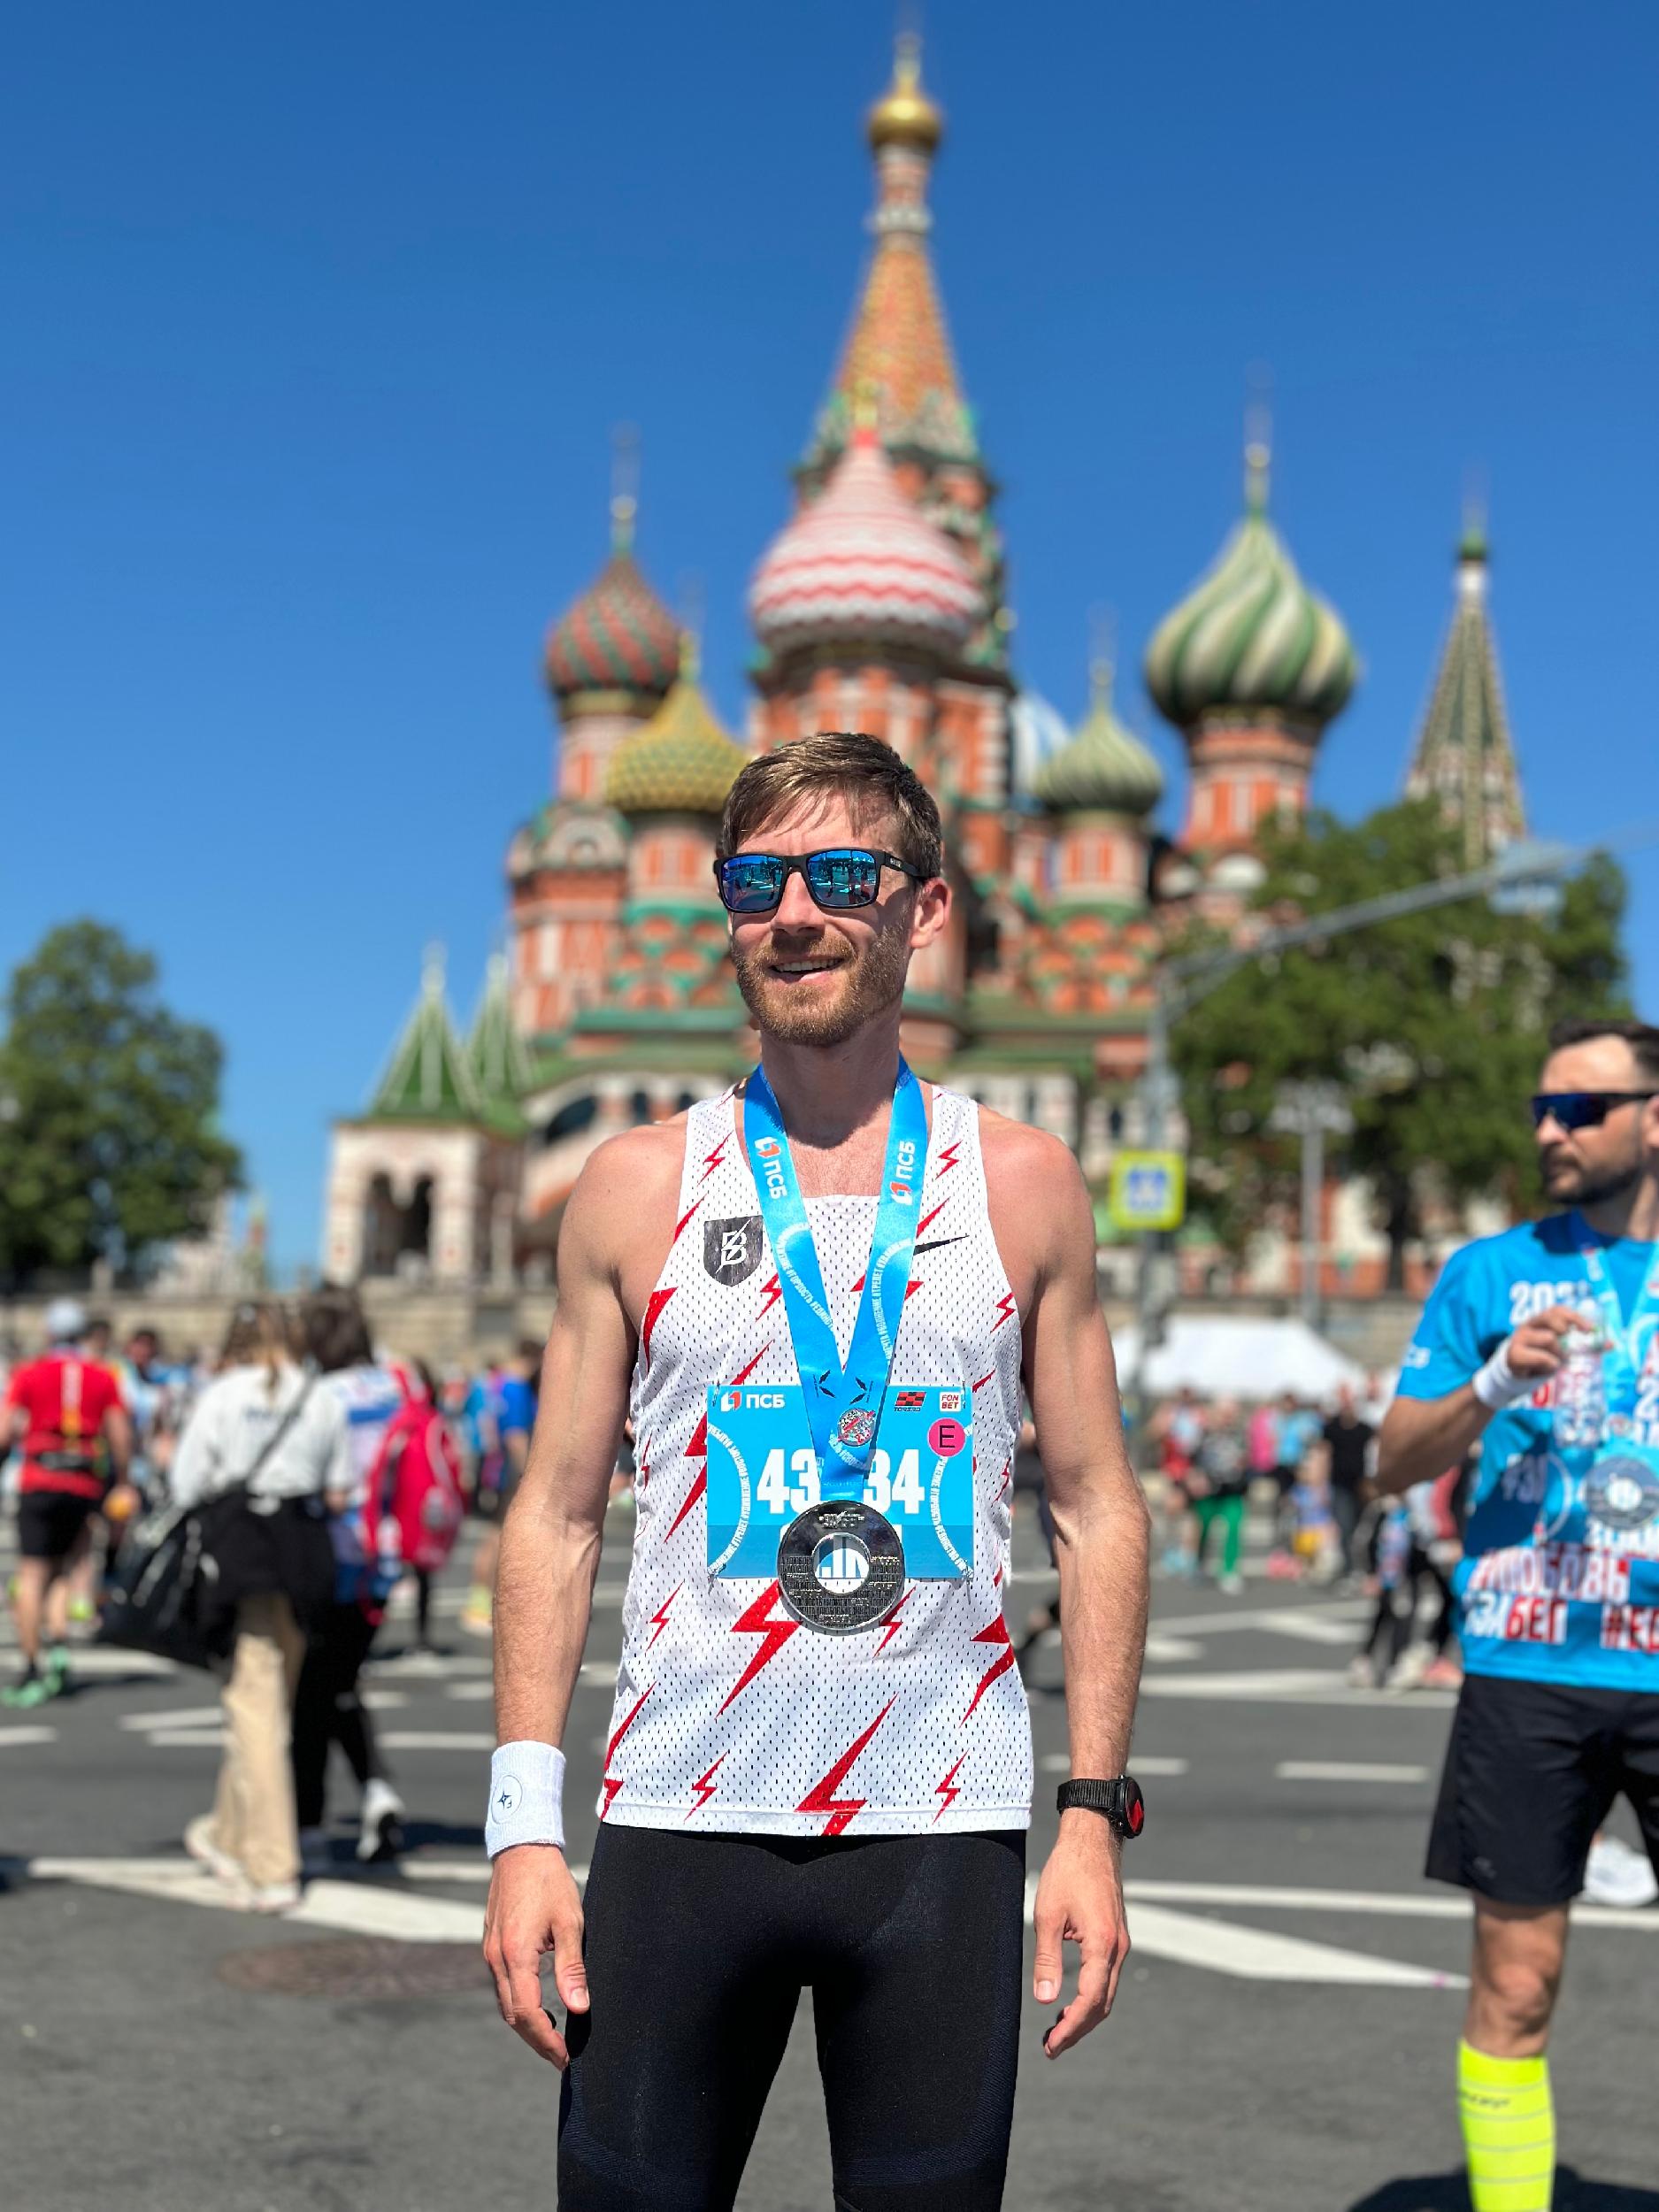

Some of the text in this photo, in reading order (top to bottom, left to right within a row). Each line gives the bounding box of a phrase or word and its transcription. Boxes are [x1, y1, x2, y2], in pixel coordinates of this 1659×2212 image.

[895, 1141, 915, 1179] ПСБ
[763, 1159, 787, 1200] ПСБ
[746, 1394, 786, 1409] ПСБ
